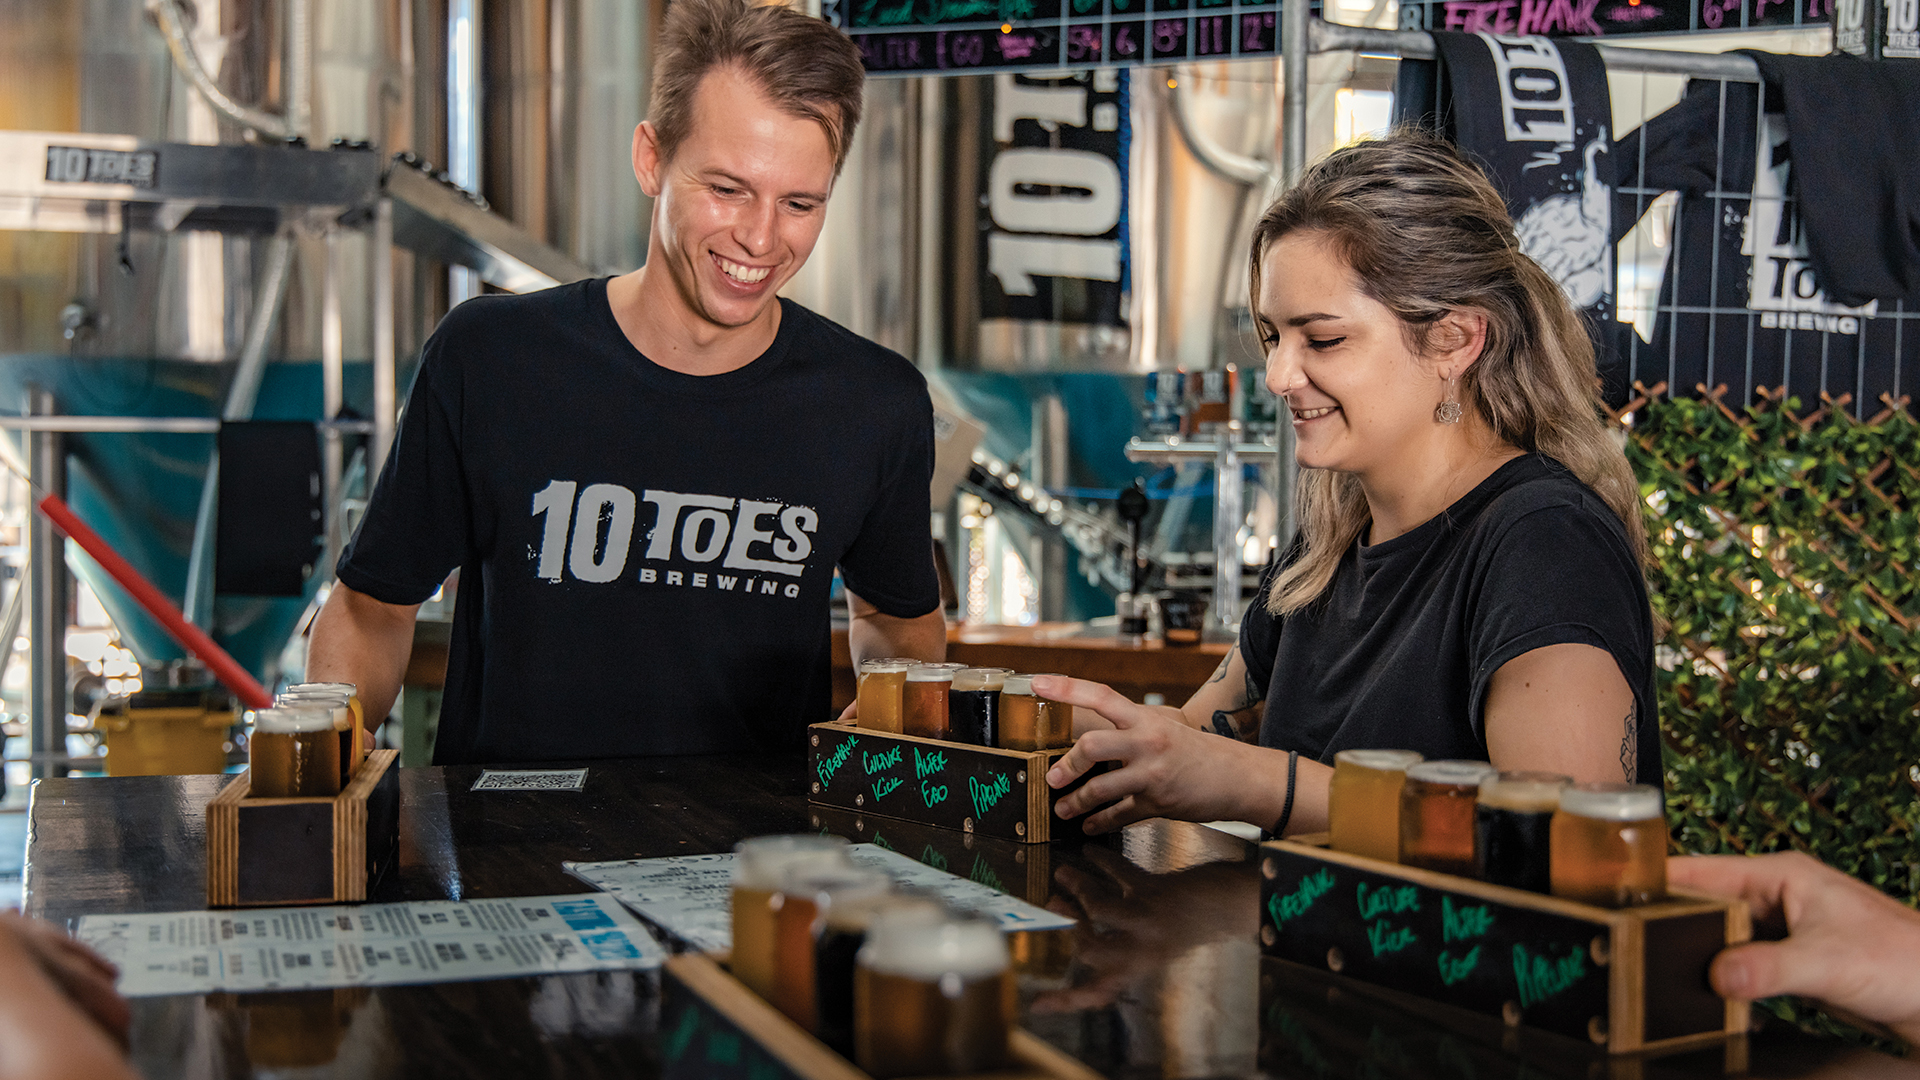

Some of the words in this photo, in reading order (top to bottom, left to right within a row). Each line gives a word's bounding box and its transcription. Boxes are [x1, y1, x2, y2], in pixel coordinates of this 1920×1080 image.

[47, 148, 89, 182] 10
[89, 152, 157, 181] TOES
[987, 147, 1122, 297] 10
[532, 480, 636, 583] 10
[643, 489, 819, 577] TOES
[639, 568, 800, 598] BREWING
[863, 745, 903, 775] CULTURE
[914, 747, 948, 780] ALTER
[921, 780, 948, 808] EGO
